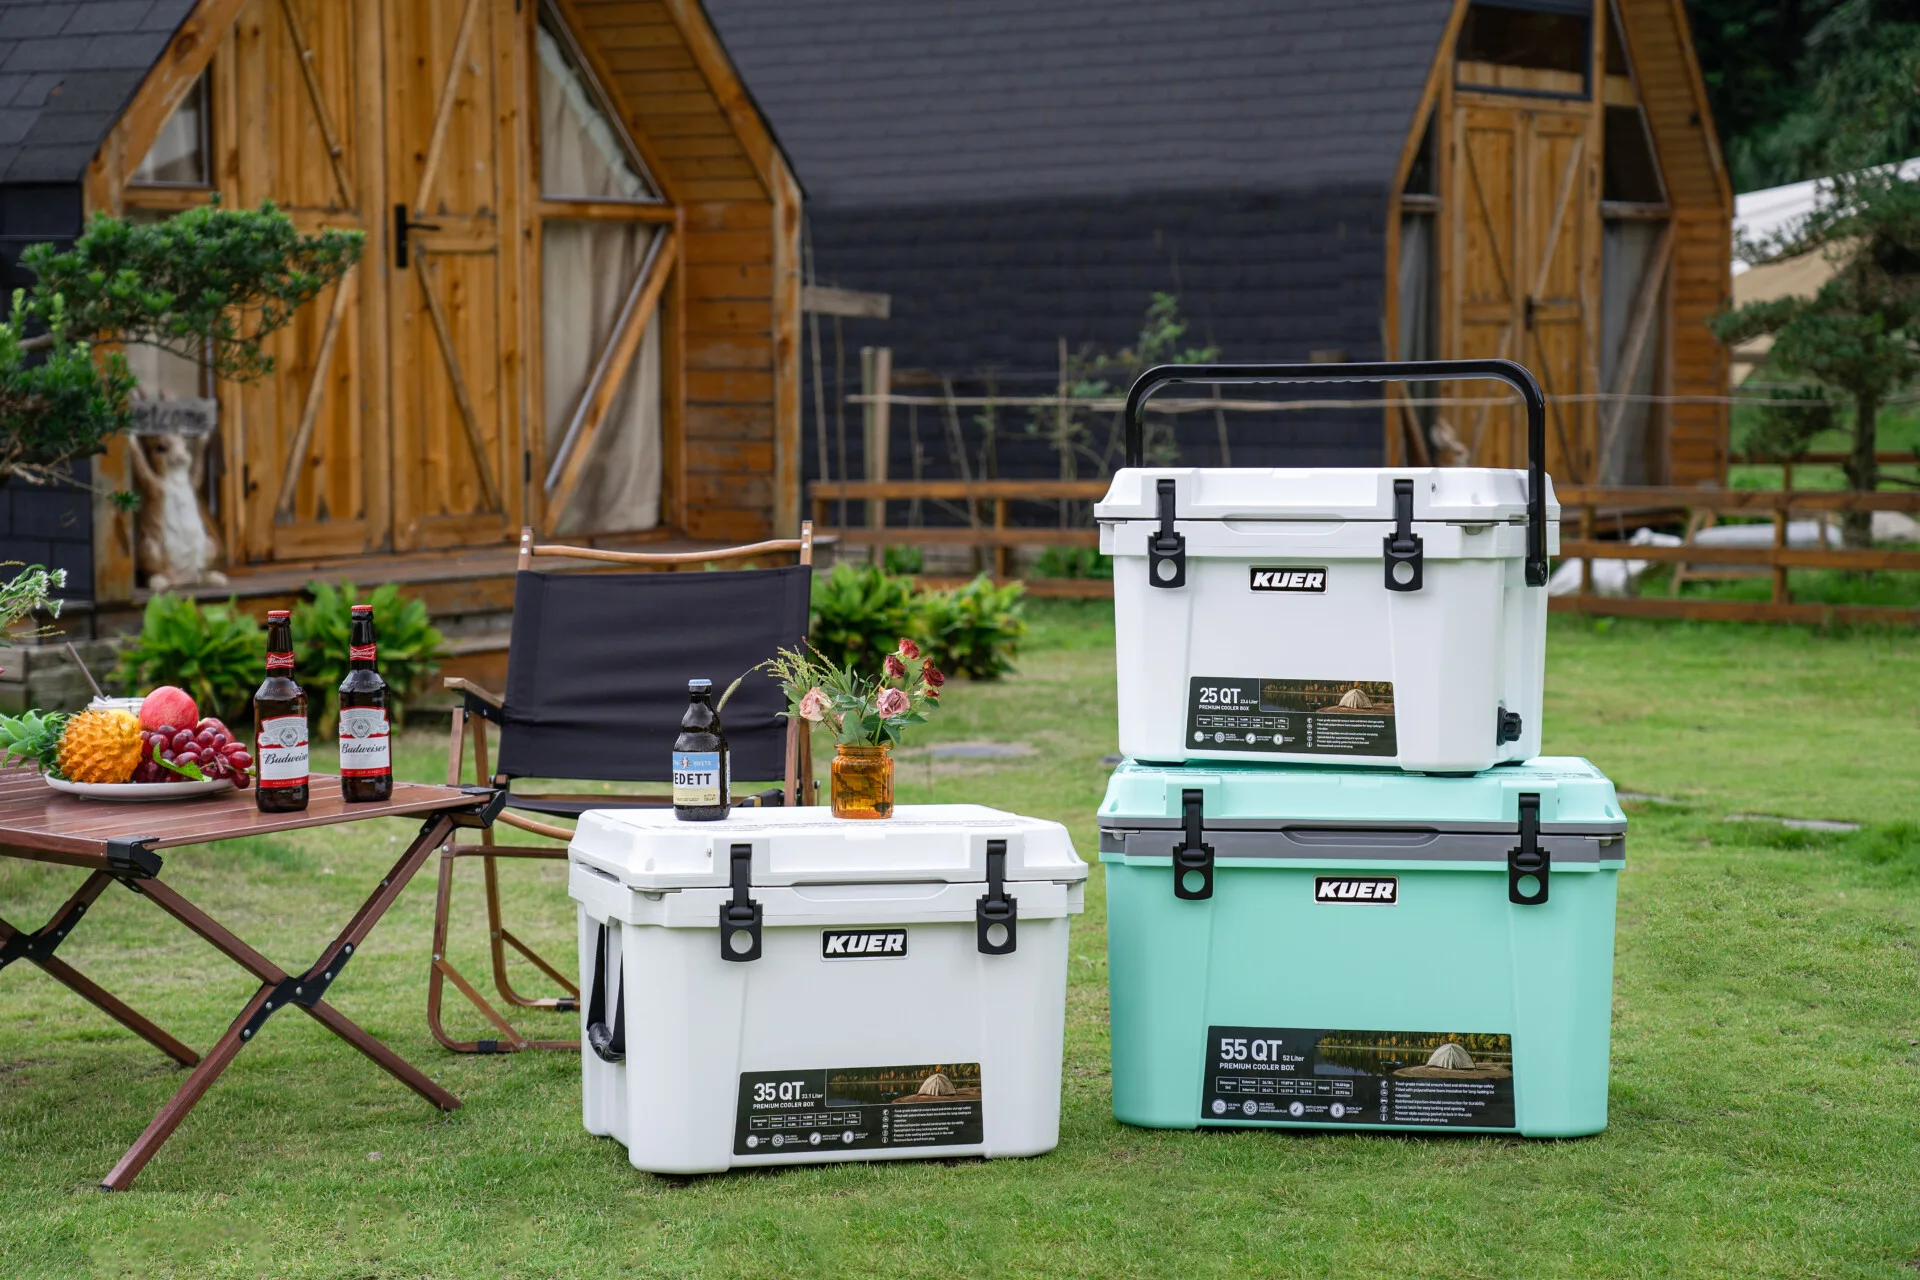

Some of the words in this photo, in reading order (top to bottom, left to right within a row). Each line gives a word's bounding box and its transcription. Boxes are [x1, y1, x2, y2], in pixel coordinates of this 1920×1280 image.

[131, 403, 207, 430] elcome
[1253, 572, 1324, 588] KUER
[1200, 687, 1218, 704] 25
[1220, 688, 1241, 704] QT
[341, 743, 386, 754] Budweiser
[263, 752, 309, 765] Budweise
[674, 773, 711, 785] EDETT
[1318, 882, 1394, 899] KUER
[825, 934, 904, 953] KUER
[1221, 1039, 1247, 1060] 55
[1251, 1040, 1282, 1061] QT
[754, 1083, 776, 1101] 35
[779, 1081, 804, 1100] QT
